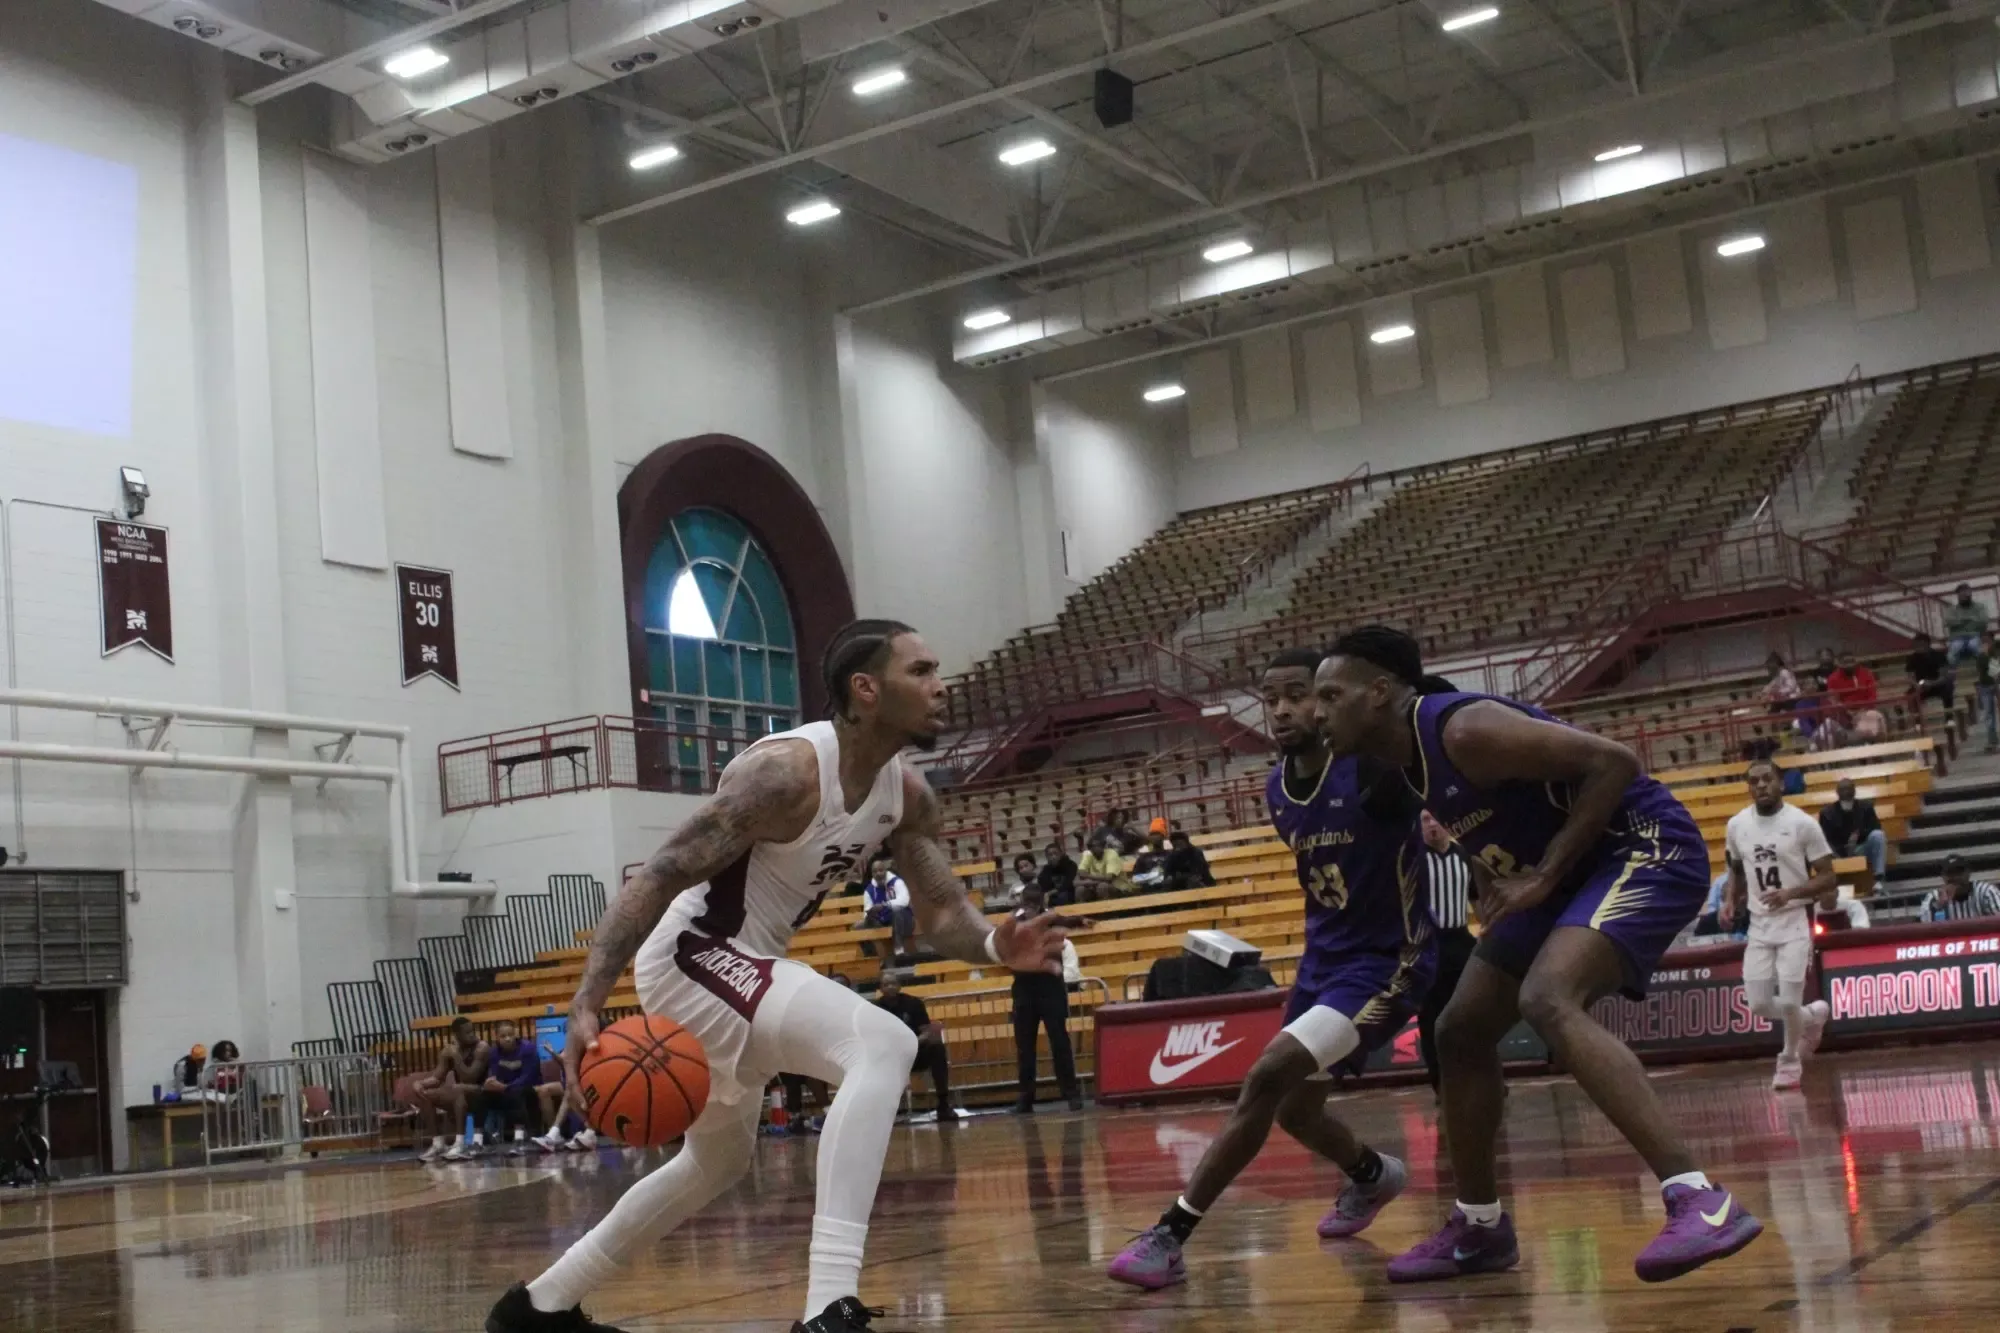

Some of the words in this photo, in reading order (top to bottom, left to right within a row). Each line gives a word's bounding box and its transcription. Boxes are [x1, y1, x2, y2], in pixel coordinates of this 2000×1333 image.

[117, 525, 147, 540] NCAA
[409, 581, 443, 599] ELLIS
[416, 601, 439, 627] 30
[1308, 863, 1349, 910] 23
[1755, 865, 1782, 892] 14
[1896, 944, 1940, 960] HOME
[1945, 941, 1965, 955] OF
[1970, 938, 1999, 952] THE
[1650, 970, 1688, 984] COME
[1693, 967, 1711, 980] TO
[1831, 966, 1962, 1020] MAROON
[1968, 962, 2000, 1008] TI
[1590, 985, 1773, 1042] OREHOUS
[1162, 1020, 1226, 1058] NIKE
